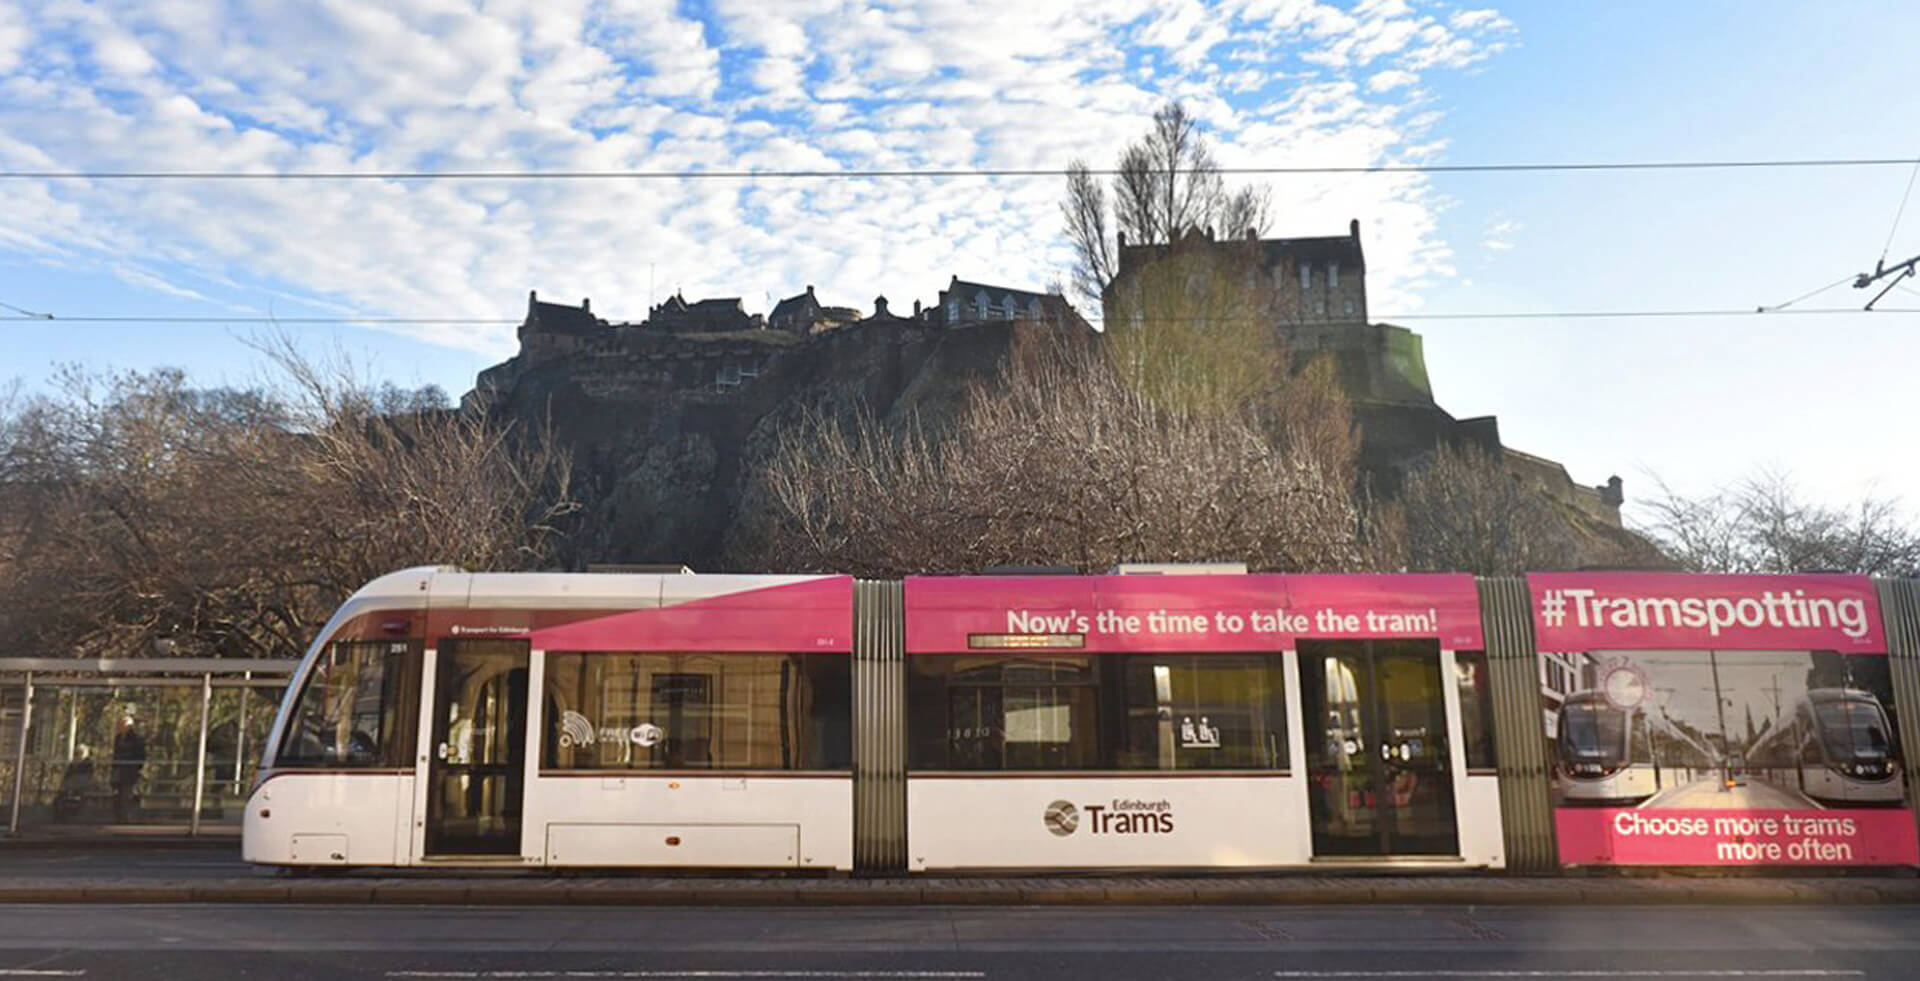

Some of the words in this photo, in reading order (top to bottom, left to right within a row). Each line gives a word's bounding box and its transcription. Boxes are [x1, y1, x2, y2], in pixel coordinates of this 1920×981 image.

[1096, 609, 1141, 634] the
[1147, 609, 1209, 634] time
[1215, 611, 1245, 633] to
[1250, 608, 1309, 633] take
[1315, 608, 1360, 632] the
[1366, 608, 1438, 632] tram!
[1541, 588, 1869, 637] #Tramspotting
[1112, 799, 1171, 812] Edinburgh
[1084, 805, 1174, 833] Trams
[1614, 812, 1708, 836] Choose
[1715, 816, 1779, 836] more
[1783, 814, 1857, 836] trams
[1717, 841, 1781, 860] more
[1788, 837, 1853, 860] often
